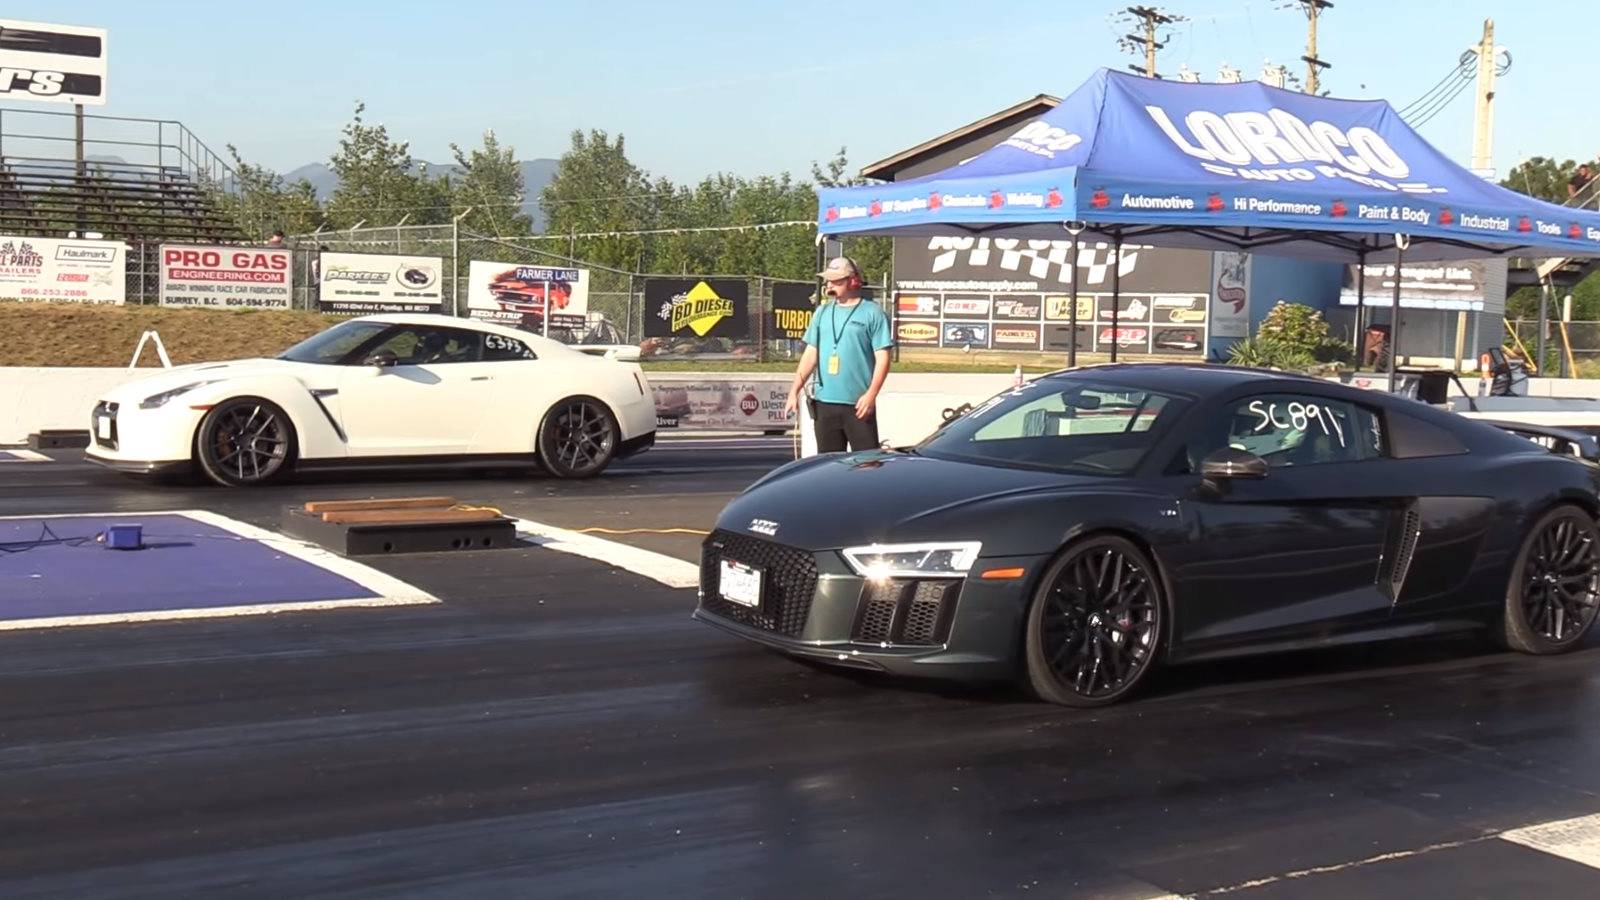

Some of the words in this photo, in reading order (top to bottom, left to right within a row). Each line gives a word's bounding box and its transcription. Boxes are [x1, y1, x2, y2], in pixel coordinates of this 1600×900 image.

[1145, 105, 1410, 179] LORDCO
[1121, 193, 1194, 210] Automotive
[1234, 197, 1247, 211] Hi
[1249, 198, 1322, 215] Performance
[1358, 204, 1389, 220] Paint
[1390, 206, 1400, 221] &
[1401, 207, 1431, 225] Body
[1460, 213, 1509, 231] Industrial
[1535, 220, 1562, 236] Tools
[63, 249, 108, 259] Haulmark
[165, 250, 221, 267] PRO
[232, 253, 287, 270] GAS
[172, 270, 281, 281] ENGINEERING.COM
[516, 268, 554, 280] FARMER
[555, 270, 579, 281] LANE
[216, 285, 233, 293] RACE
[235, 285, 248, 293] CAR
[249, 286, 287, 294] FABRICATION
[204, 297, 219, 305] B.C.
[674, 302, 693, 322] BD
[695, 299, 733, 314] DIESEL
[1248, 400, 1346, 448] SC891
